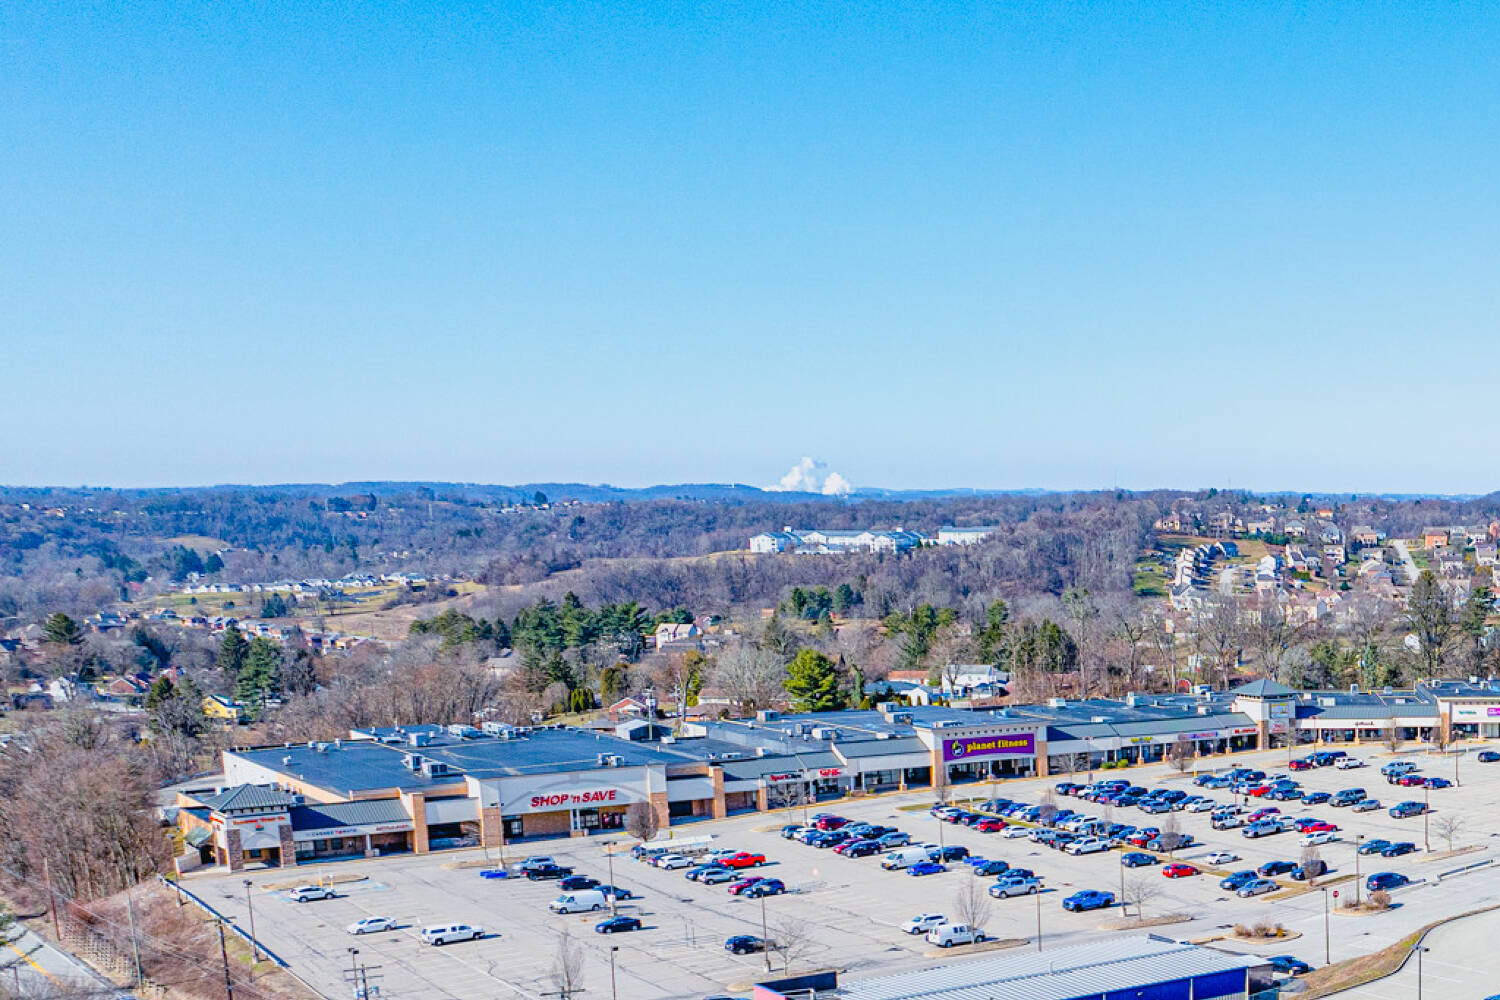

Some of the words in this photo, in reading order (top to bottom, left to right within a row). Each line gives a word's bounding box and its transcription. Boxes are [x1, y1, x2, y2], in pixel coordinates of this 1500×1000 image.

[966, 741, 996, 754] planet
[997, 739, 1028, 749] fitness
[530, 793, 569, 808] SHOP
[582, 789, 617, 804] SAVE
